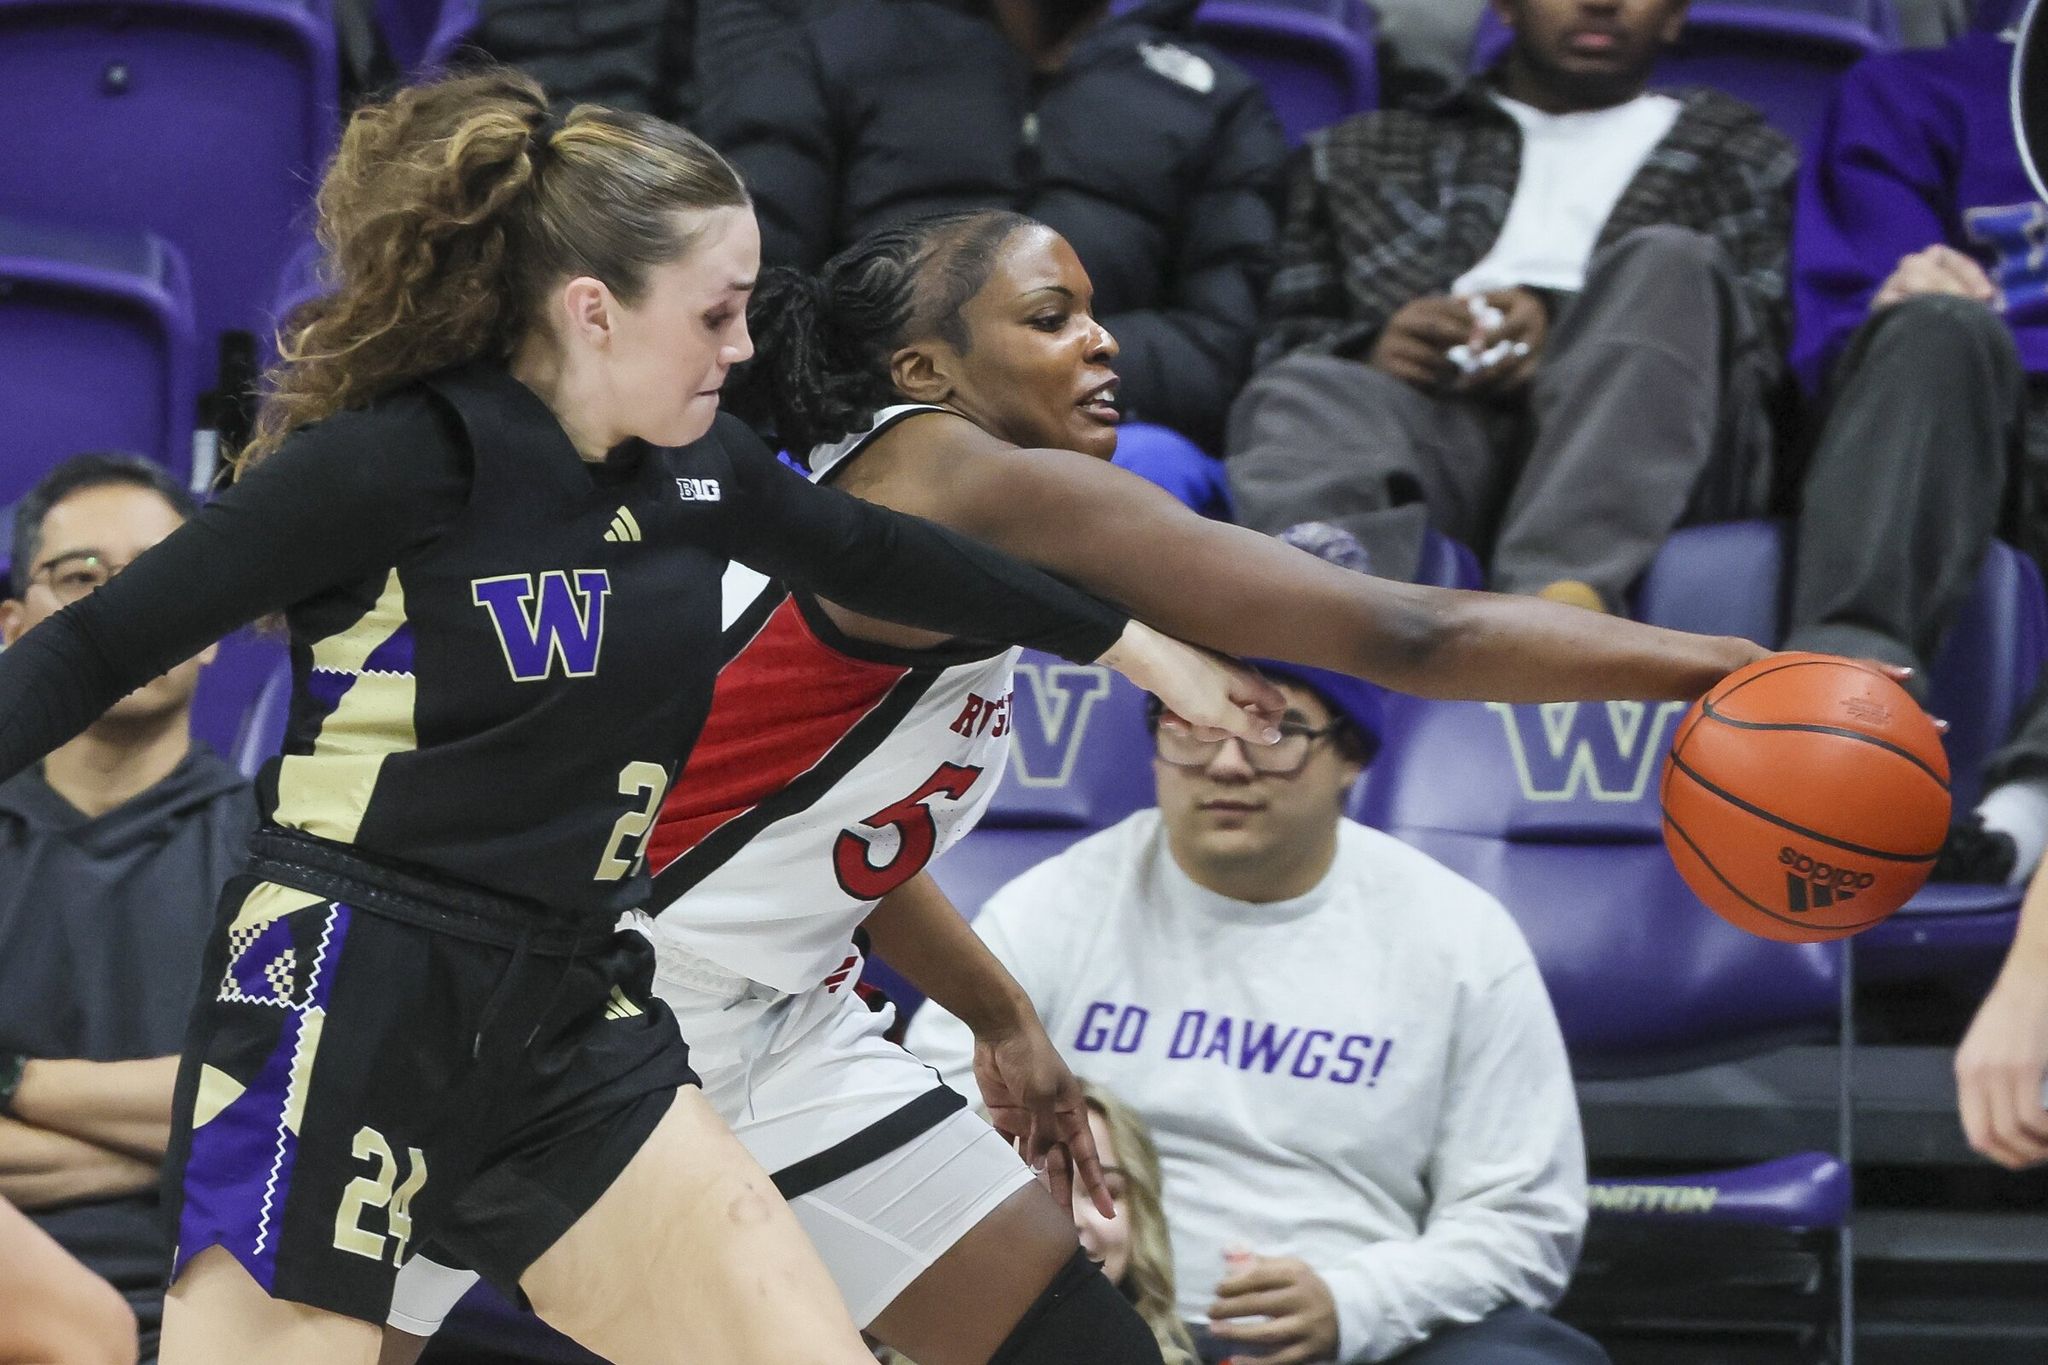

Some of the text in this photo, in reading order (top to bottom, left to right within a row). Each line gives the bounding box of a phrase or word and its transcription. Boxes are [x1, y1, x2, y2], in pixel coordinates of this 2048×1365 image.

[471, 568, 611, 682] W
[1485, 700, 1688, 801] W
[832, 760, 984, 901] 5
[1778, 846, 1875, 889] adidas
[1073, 1001, 1394, 1087] GO DAWGS!
[333, 1126, 428, 1268] 24
